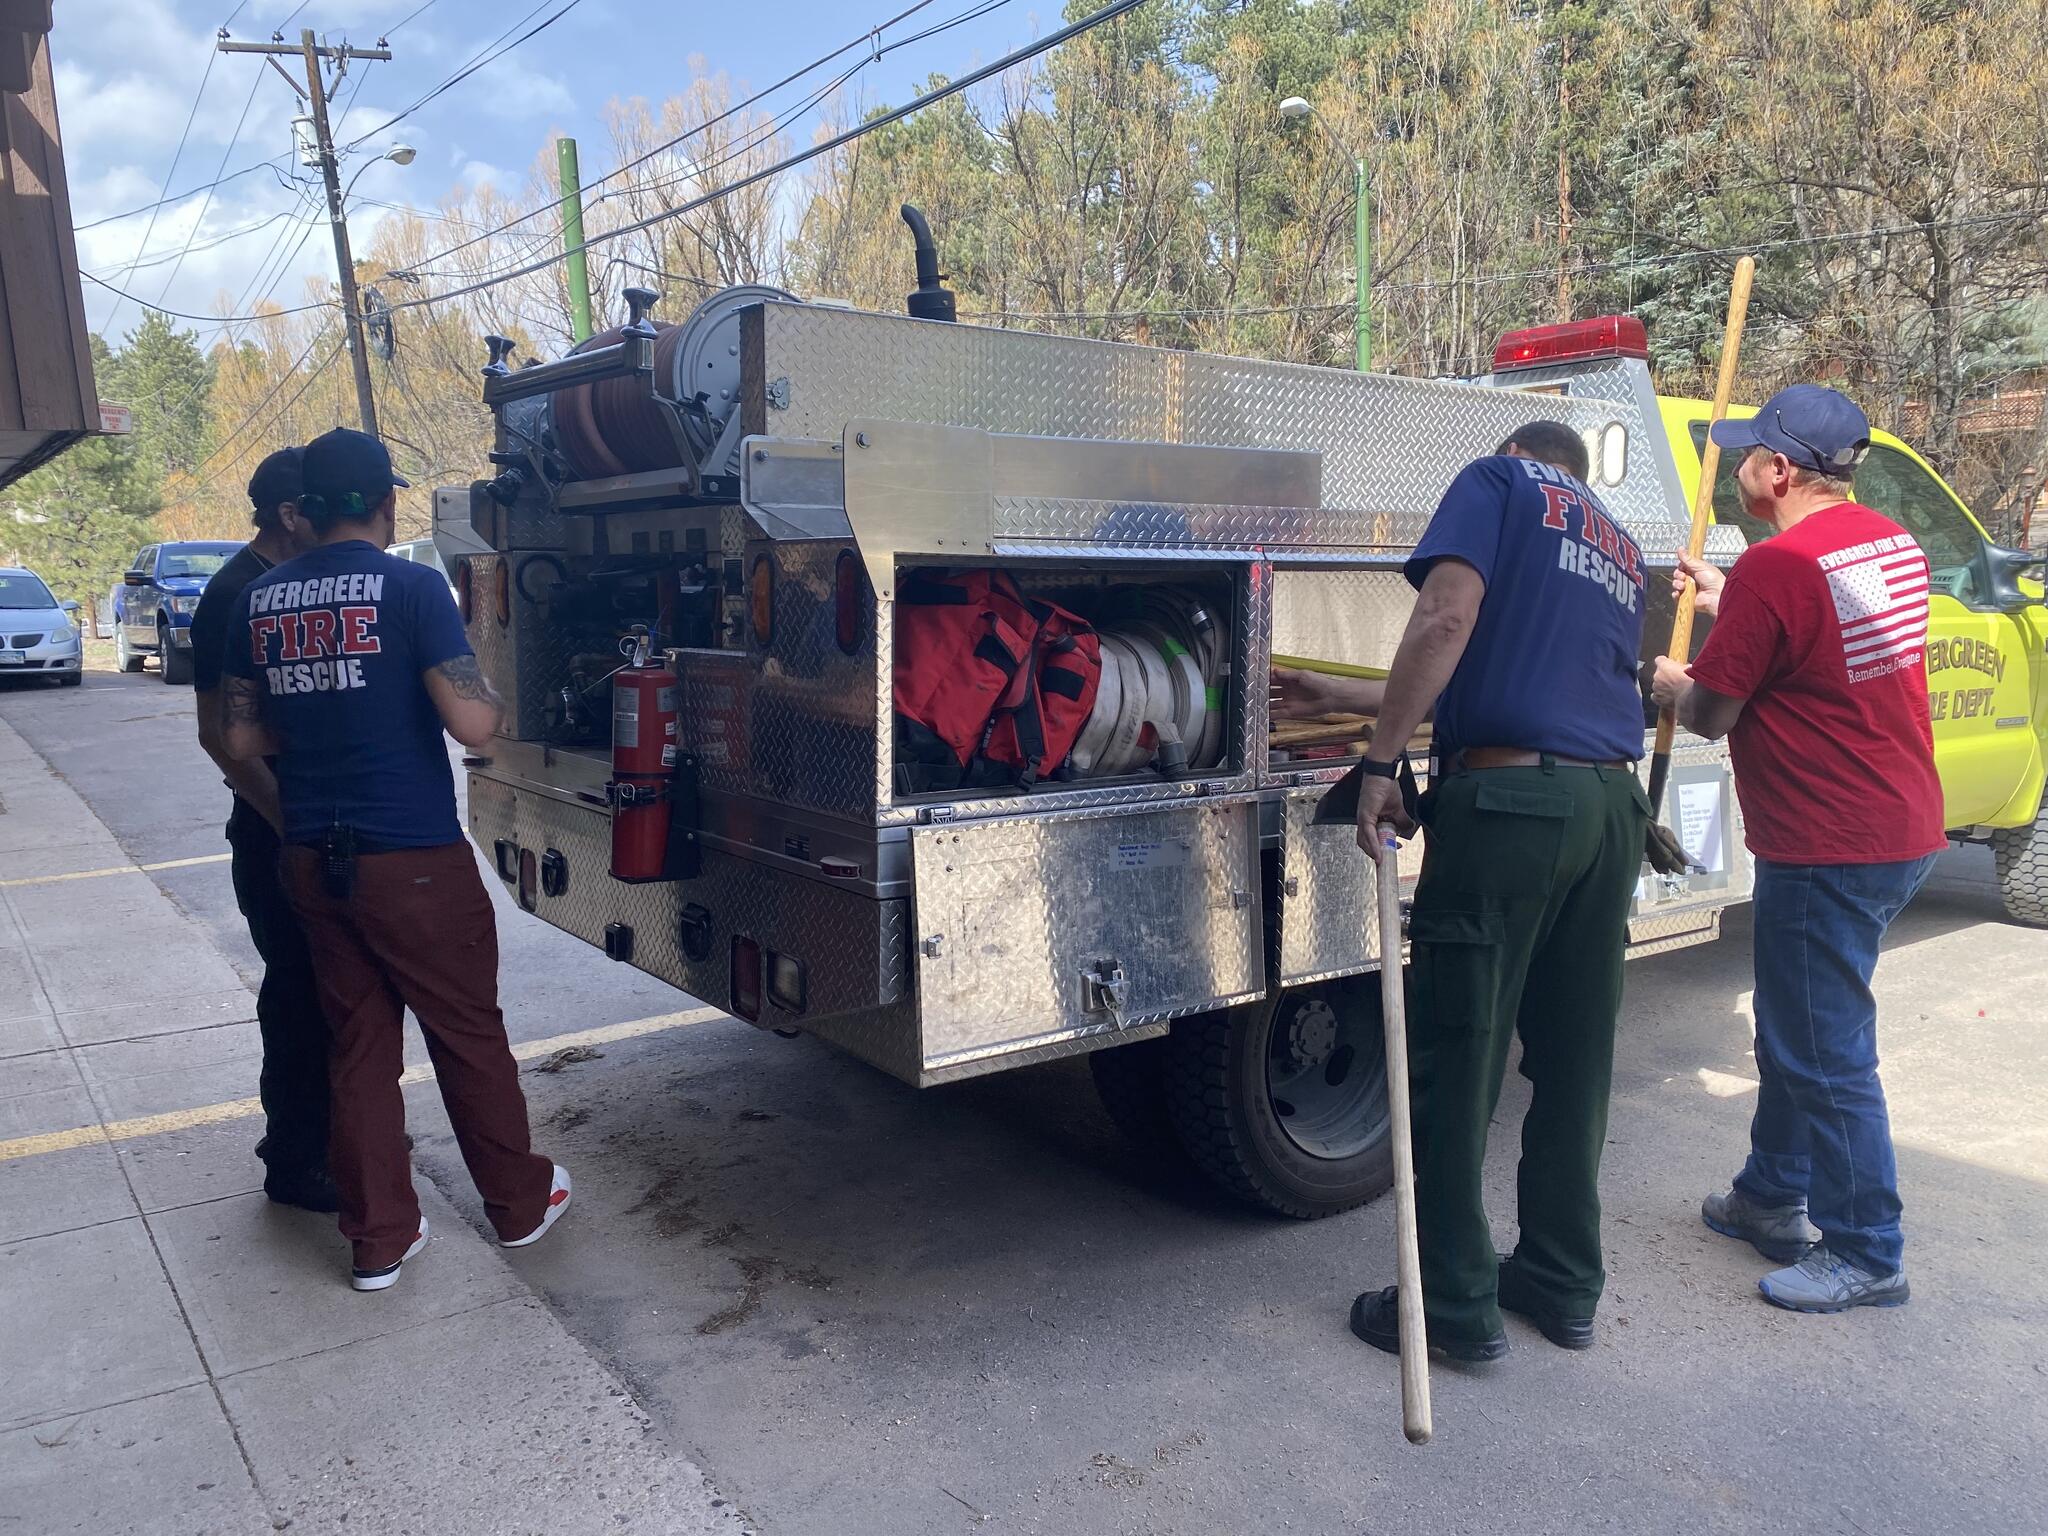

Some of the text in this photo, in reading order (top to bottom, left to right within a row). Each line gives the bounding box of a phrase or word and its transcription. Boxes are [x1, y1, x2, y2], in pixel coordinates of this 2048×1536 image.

[99, 407, 128, 416] MERGENCY
[1538, 482, 1644, 591] FIRE
[1817, 541, 1876, 571] EVERGREEN
[1874, 537, 1896, 553] FIRE
[250, 573, 384, 617] EVERGREEN
[1559, 536, 1637, 615] RESCUE
[249, 606, 381, 664] FIRE
[266, 658, 367, 695] RESCUE
[1926, 636, 2007, 683] ERGREEN
[1929, 687, 1995, 721] RE DEPT.
